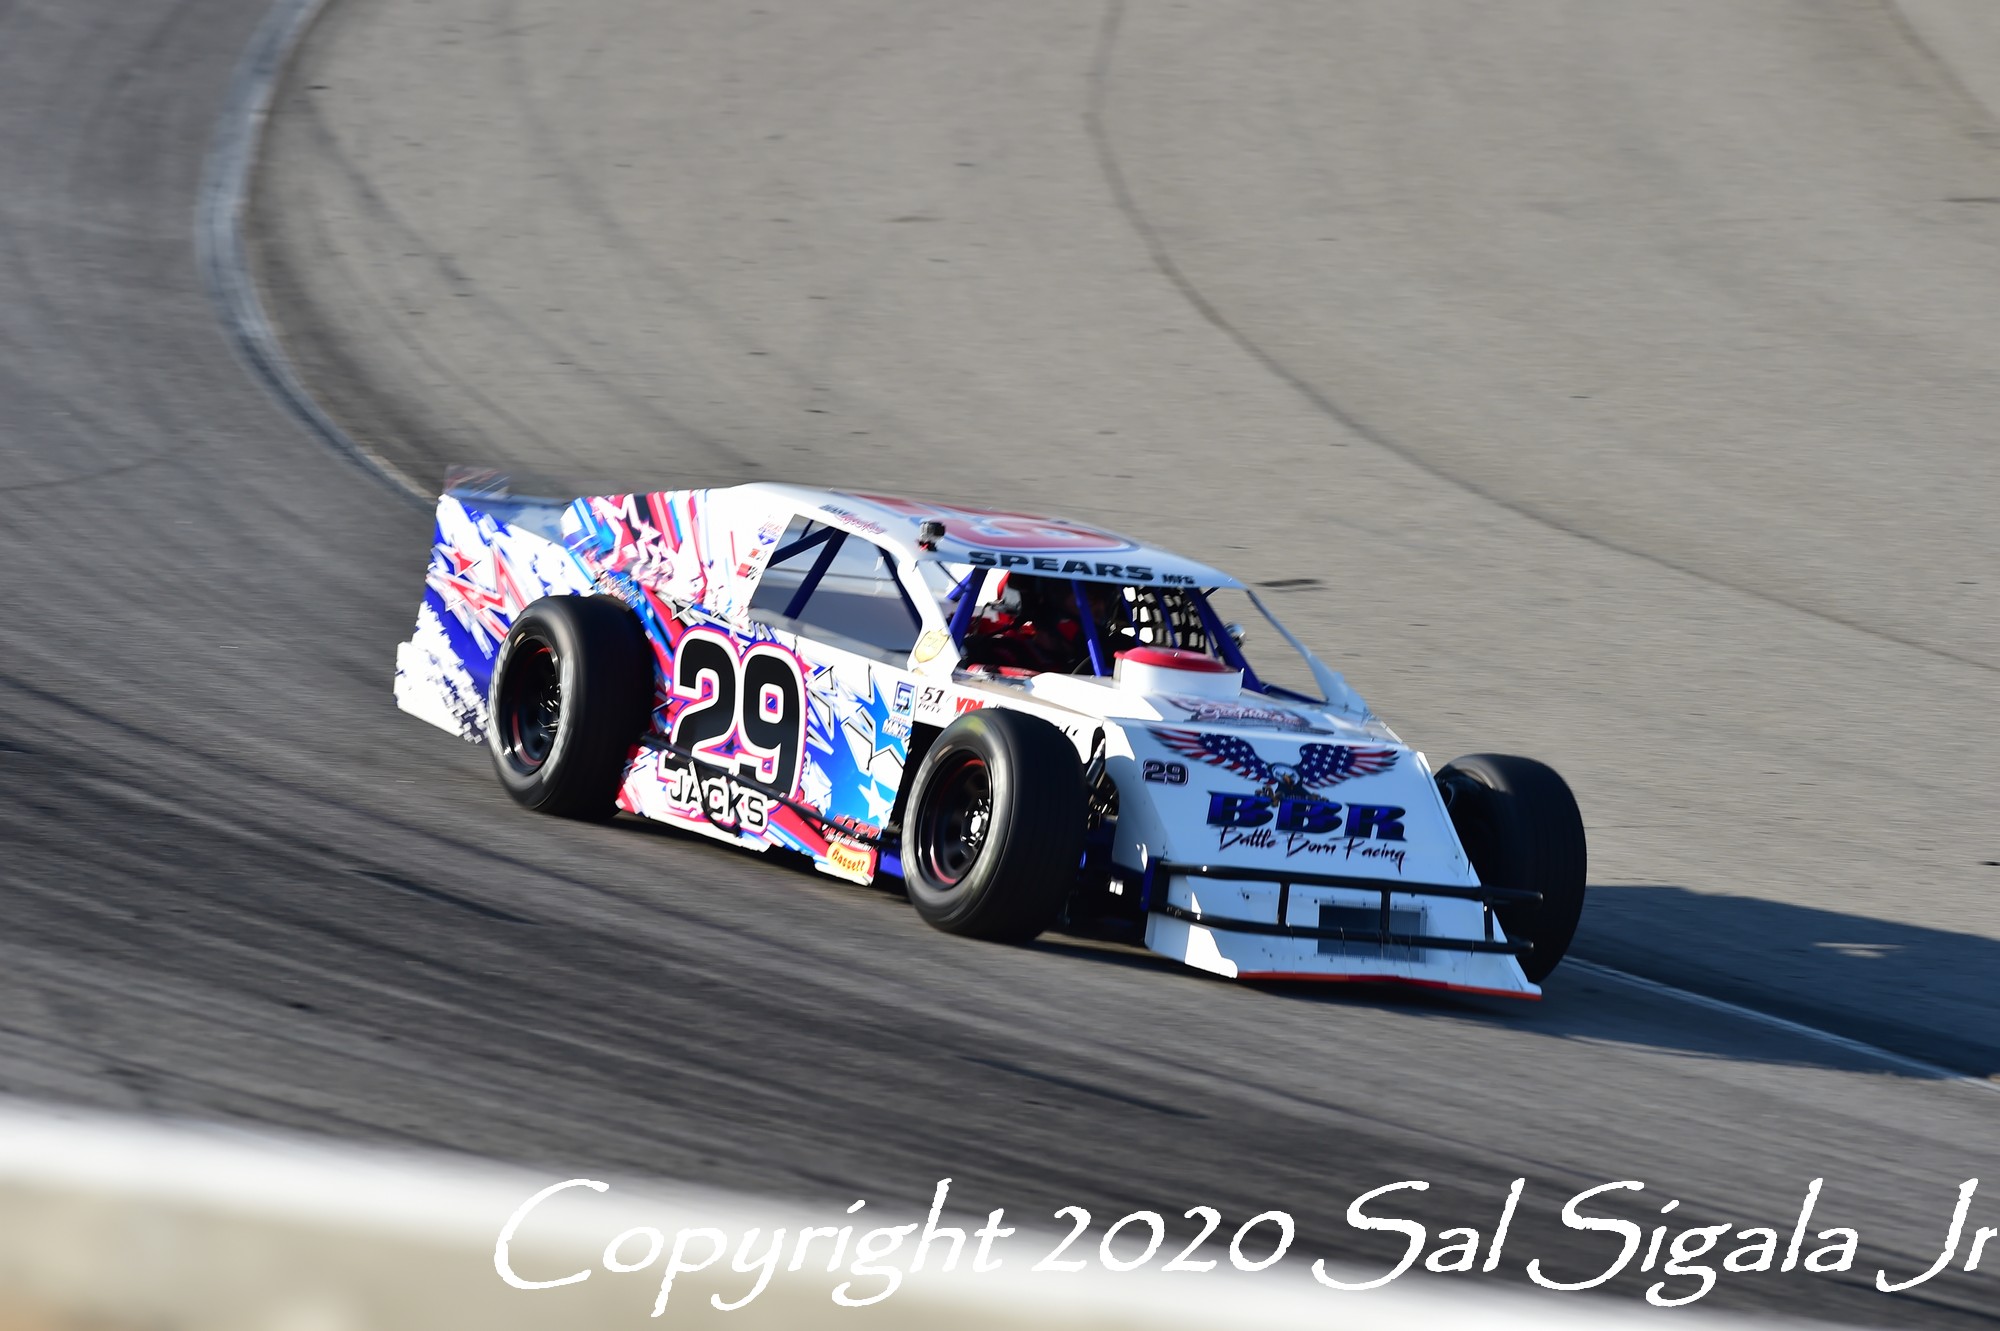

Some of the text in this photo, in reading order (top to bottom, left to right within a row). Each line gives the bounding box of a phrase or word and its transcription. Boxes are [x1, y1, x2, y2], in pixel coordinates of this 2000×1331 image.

[968, 551, 1196, 585] SPEARS MFG
[660, 635, 803, 800] 29
[919, 686, 946, 704] 51
[1142, 759, 1189, 786] 29
[667, 772, 766, 830] JACKS
[1207, 790, 1407, 842] BBR
[1218, 825, 1408, 875] Battle Born Racing
